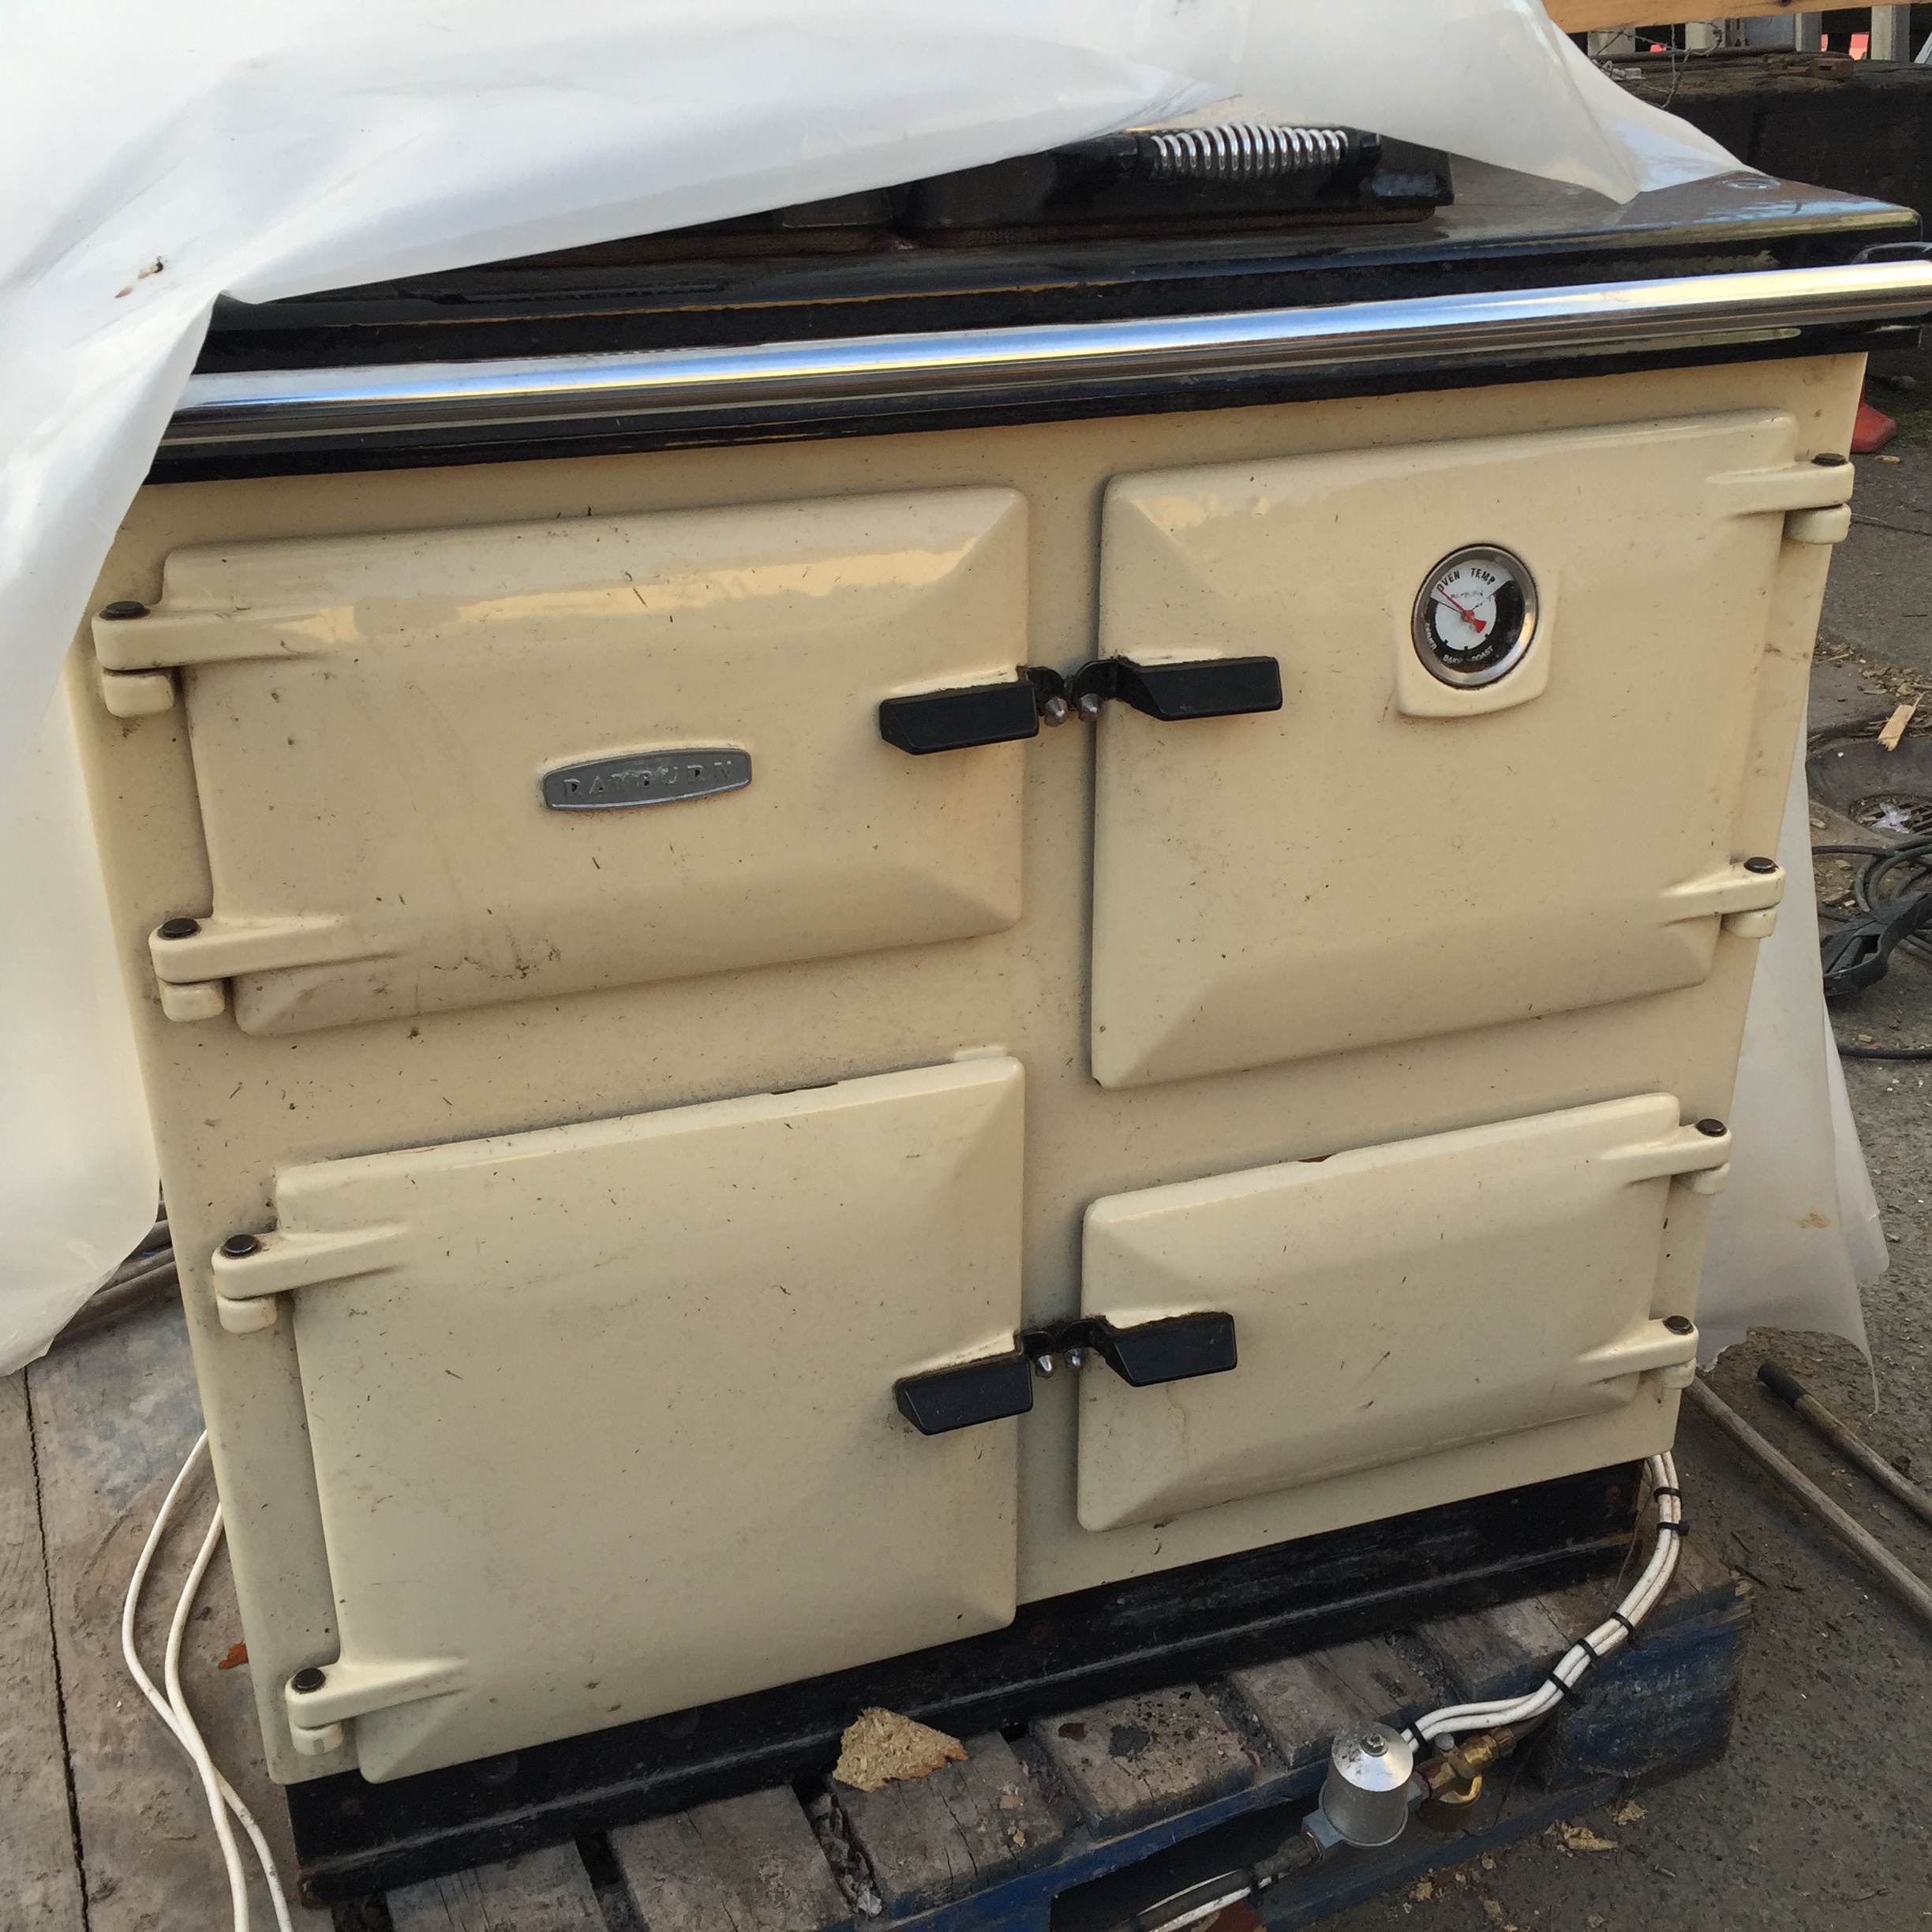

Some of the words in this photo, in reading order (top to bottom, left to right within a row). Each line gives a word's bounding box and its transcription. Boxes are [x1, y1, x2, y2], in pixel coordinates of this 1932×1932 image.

[1436, 570, 1460, 591] OVEN
[1470, 567, 1496, 585] TEMP
[563, 760, 734, 798] RAYBURN
